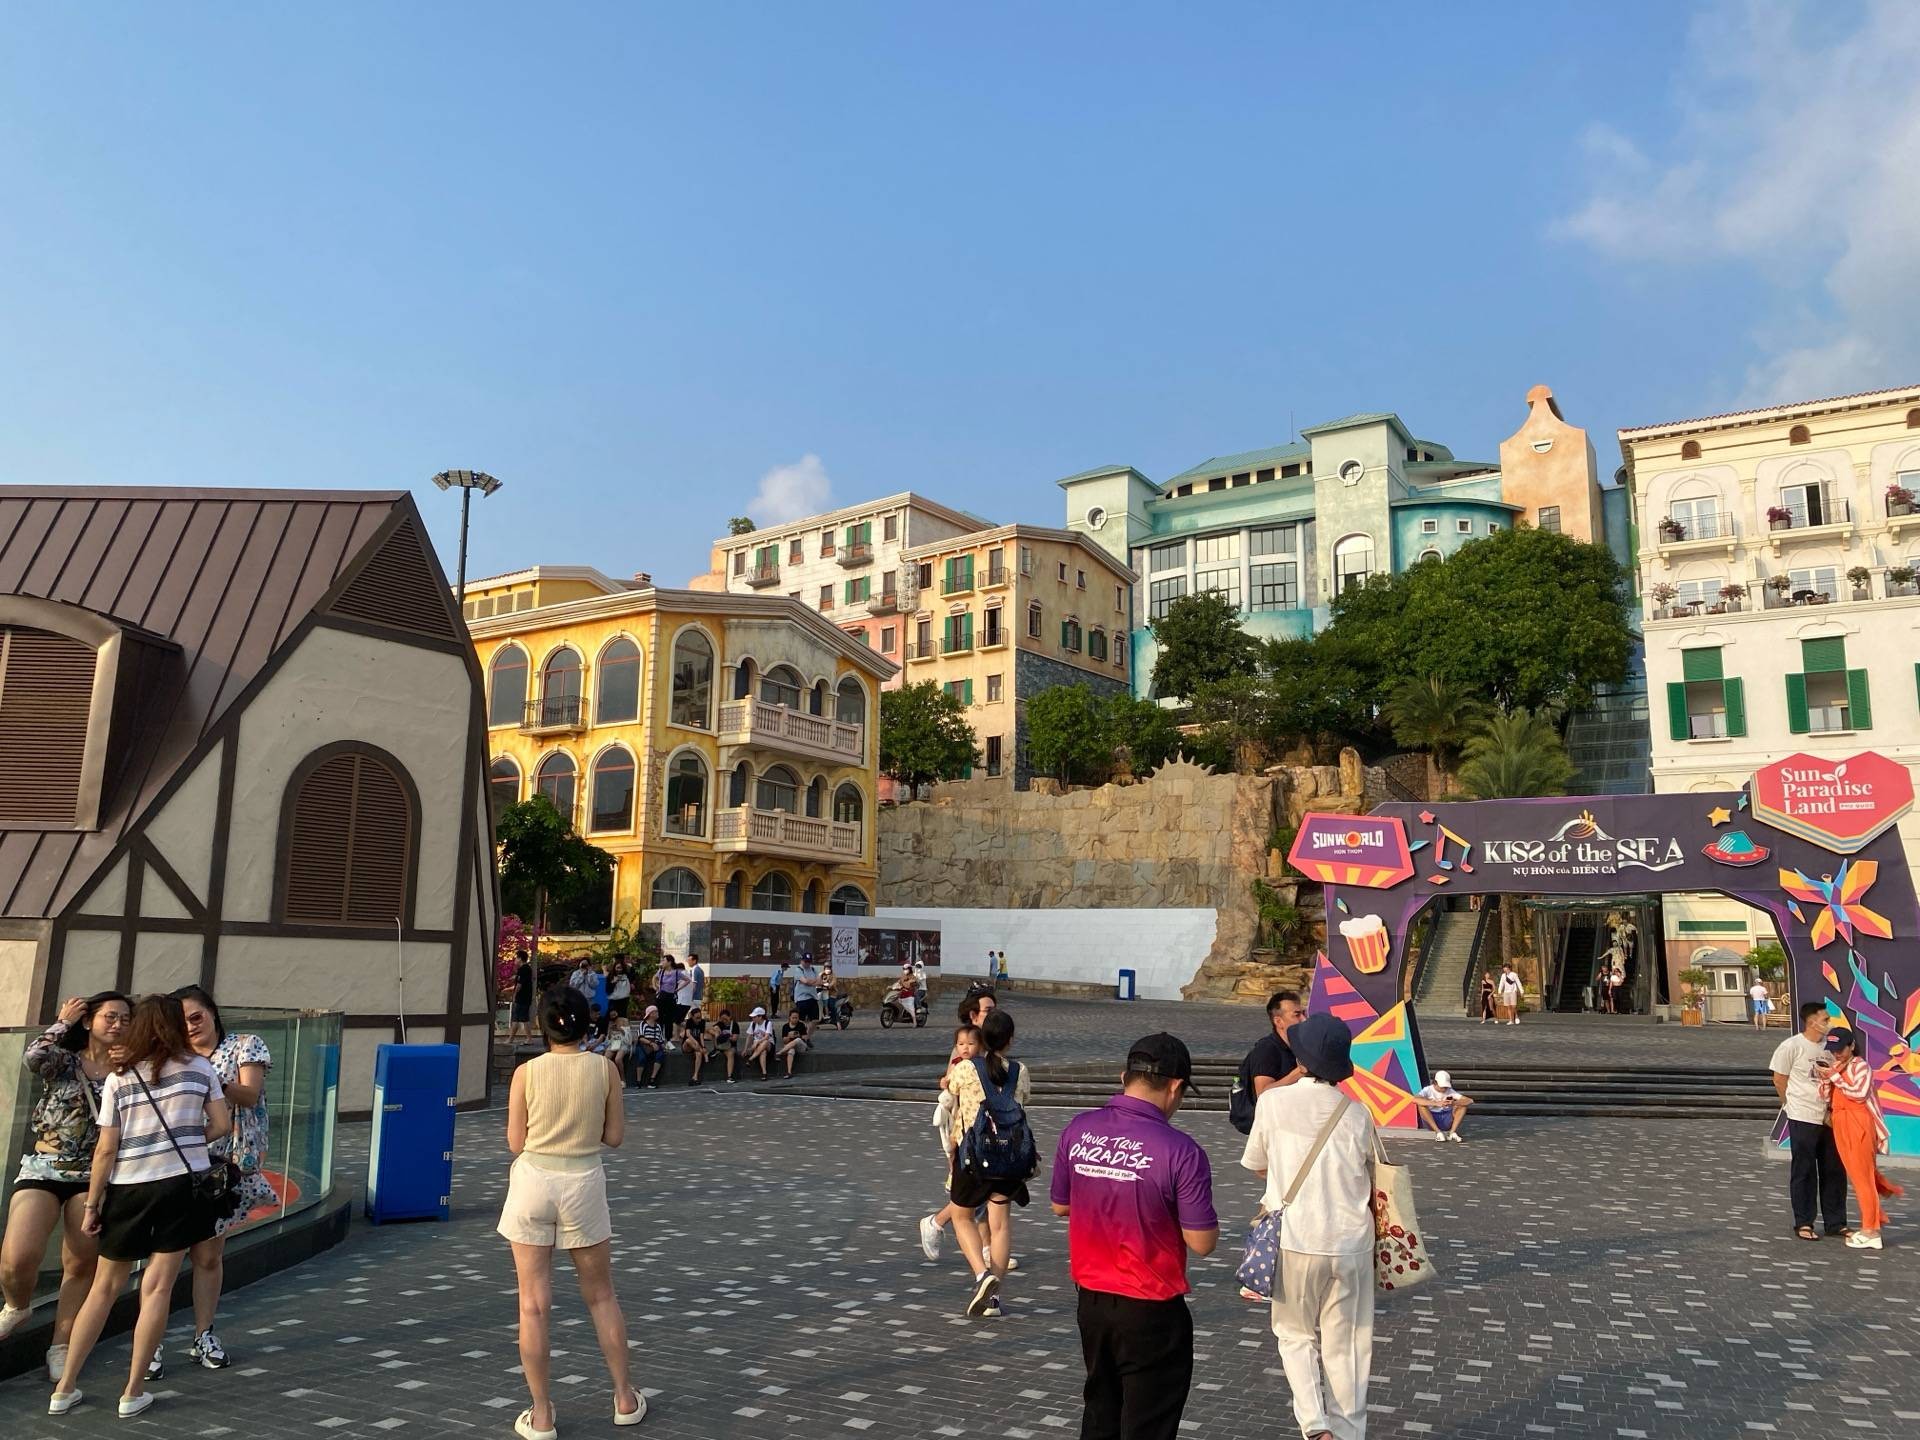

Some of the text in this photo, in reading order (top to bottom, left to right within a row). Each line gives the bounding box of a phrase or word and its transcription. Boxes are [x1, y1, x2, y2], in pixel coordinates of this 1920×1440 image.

[1780, 767, 1822, 783] Sun
[1782, 780, 1873, 798] Paradise
[1784, 797, 1836, 815] Land
[1482, 837, 1684, 864] KISS of the SEA
[1081, 1131, 1144, 1151] YOUR TRUE
[1068, 1143, 1154, 1170] PARADISE
